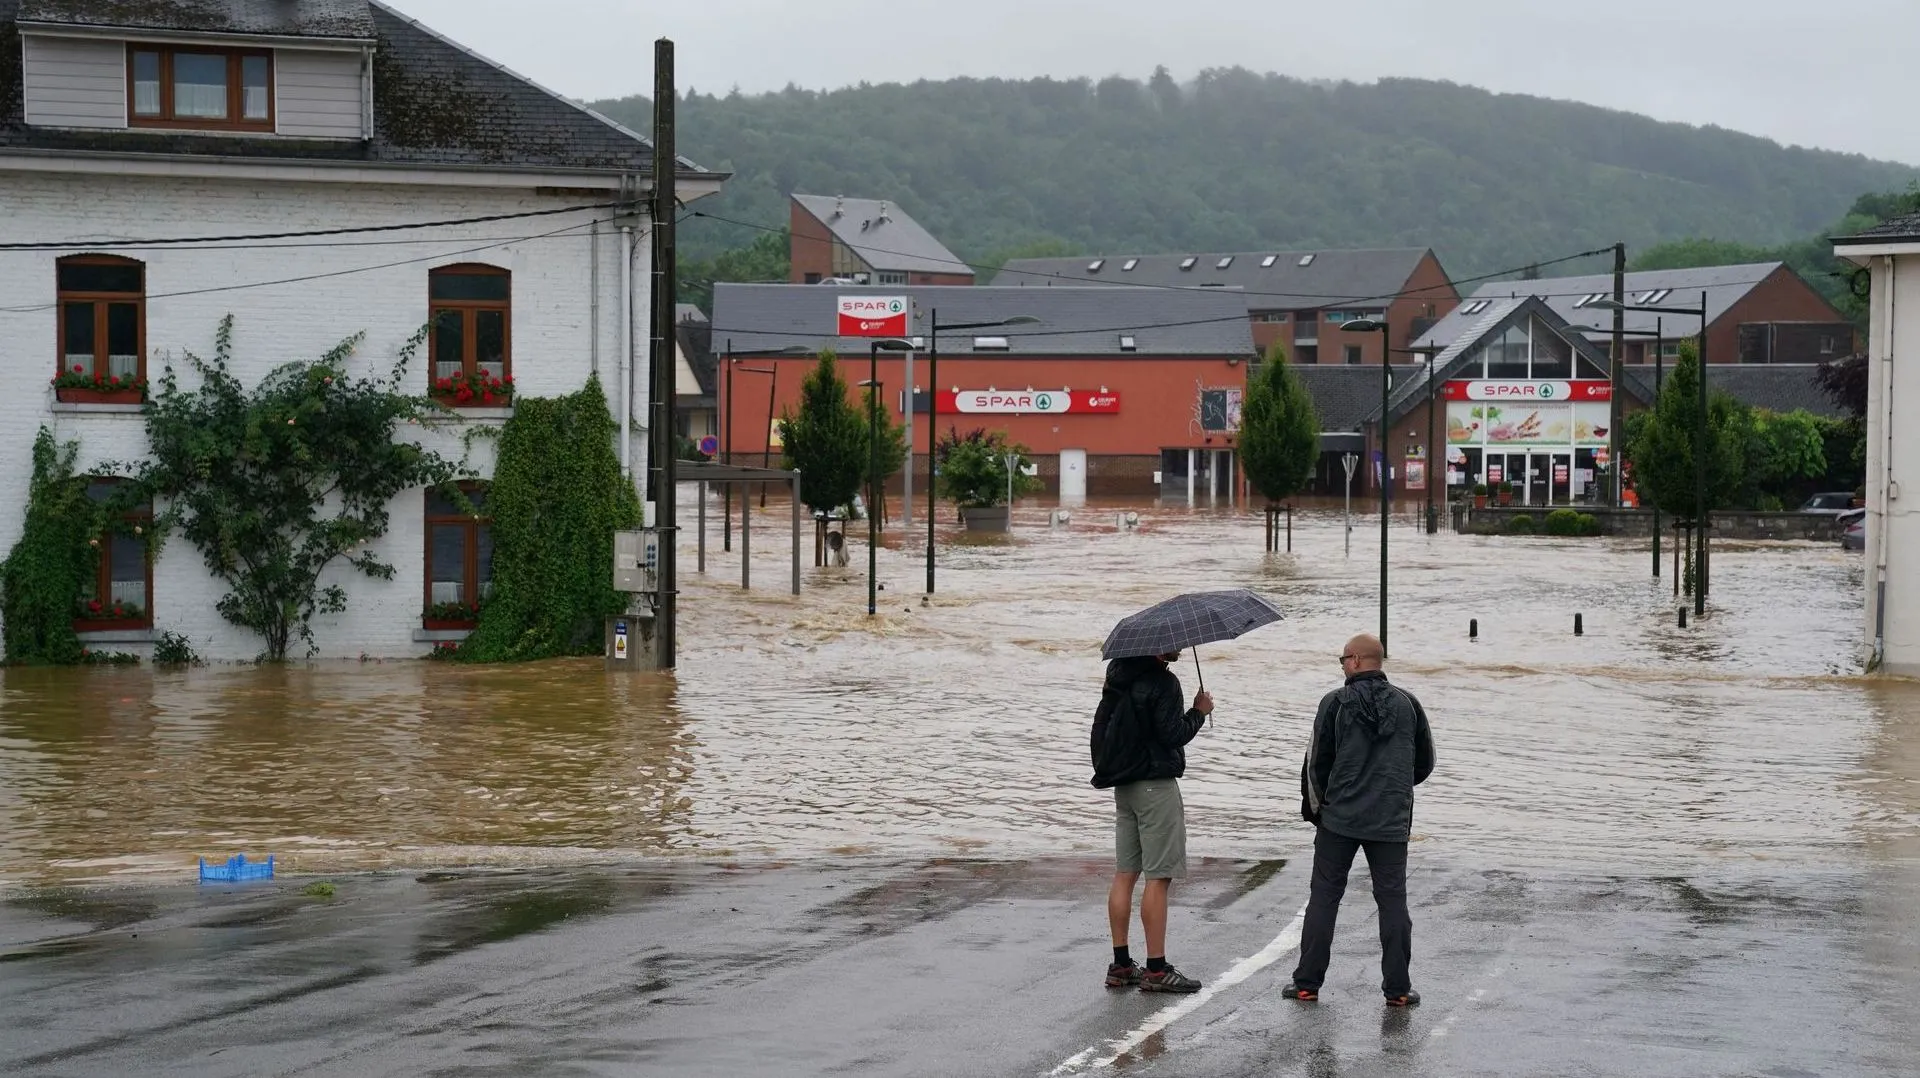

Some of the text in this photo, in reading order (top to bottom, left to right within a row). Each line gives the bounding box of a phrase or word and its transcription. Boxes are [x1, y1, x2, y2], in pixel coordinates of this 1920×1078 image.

[842, 302, 886, 311] SPAR
[1484, 385, 1535, 395] SPAR
[975, 396, 1032, 407] SPAR
